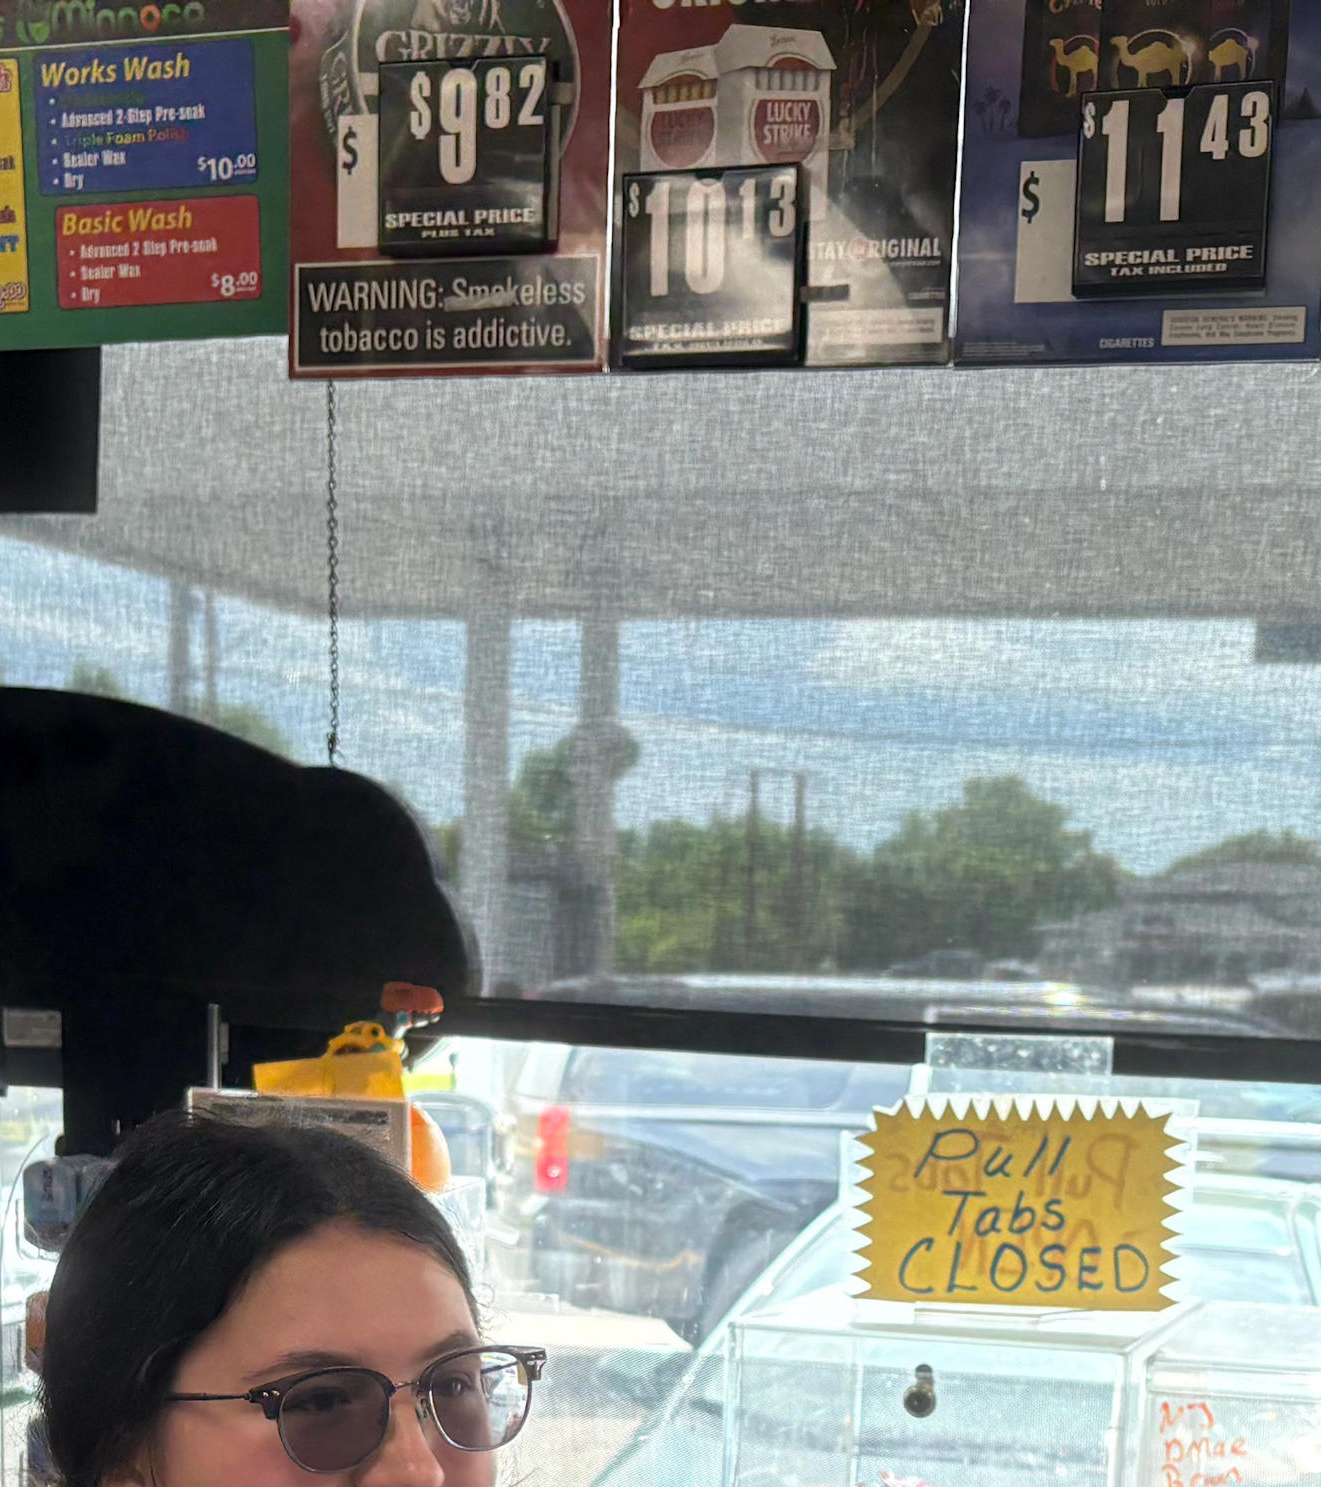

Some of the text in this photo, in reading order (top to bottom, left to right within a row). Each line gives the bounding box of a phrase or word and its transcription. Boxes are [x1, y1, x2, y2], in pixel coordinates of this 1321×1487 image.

[41, 56, 190, 87] Works Wash
[767, 103, 812, 123] LUCKY
[763, 122, 813, 144] STRIKE
[342, 126, 359, 174] $
[1022, 172, 1040, 223] $
[62, 209, 193, 236] Basic Wash
[386, 207, 536, 229] SPECIAL PRICE
[465, 227, 495, 236] TAX
[1085, 245, 1253, 266] SPECIAL PRICE
[1109, 263, 1227, 276] TAX INCLUDED
[212, 271, 258, 297] $8.00
[308, 280, 445, 312] WARNING:
[320, 318, 572, 351] tobacco is addictive.
[1099, 337, 1154, 348] CIGARETTES
[914, 1129, 1072, 1178] Pull
[941, 1190, 1065, 1236] Tabs
[898, 1237, 1149, 1293] CLOSED
